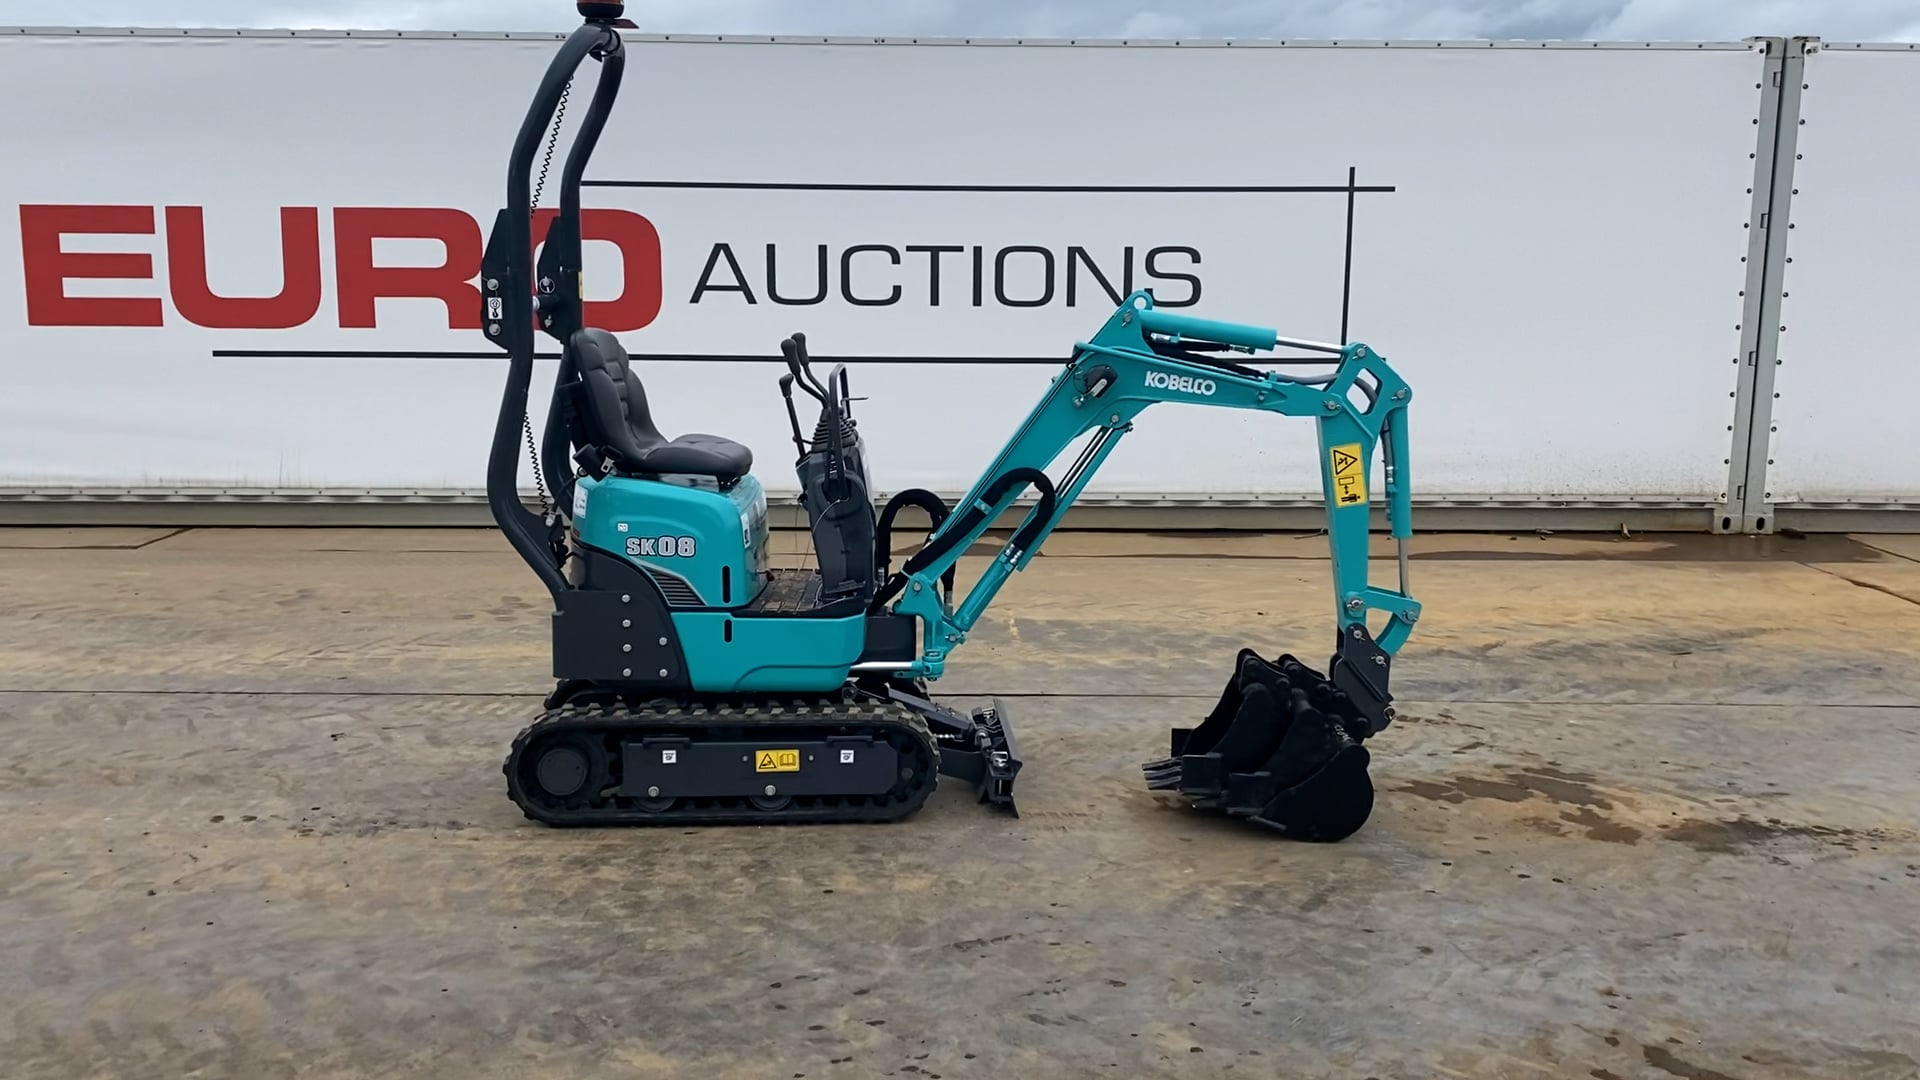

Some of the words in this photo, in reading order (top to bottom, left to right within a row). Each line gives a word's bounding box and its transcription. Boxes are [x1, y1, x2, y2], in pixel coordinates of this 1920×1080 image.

[19, 204, 662, 331] EURO
[689, 242, 1202, 308] AUCTIONS
[1144, 370, 1217, 396] KOBELCO
[626, 535, 697, 558] SK08
